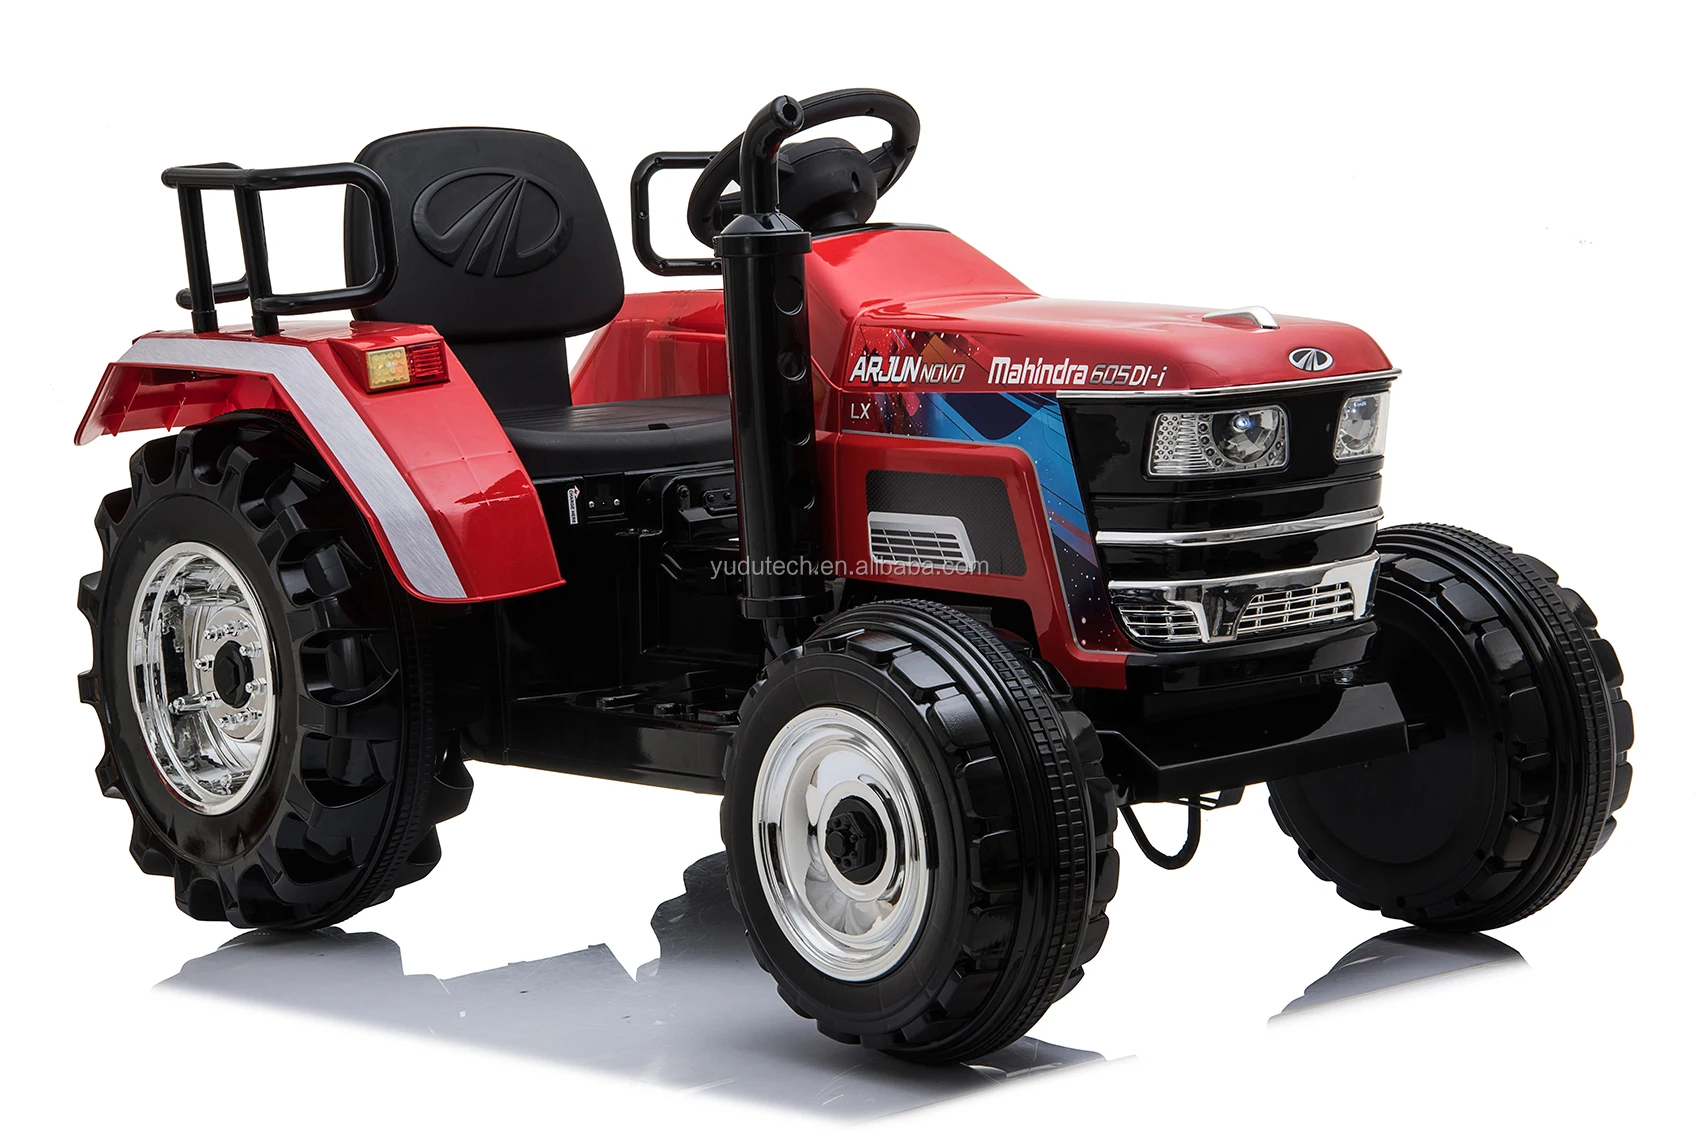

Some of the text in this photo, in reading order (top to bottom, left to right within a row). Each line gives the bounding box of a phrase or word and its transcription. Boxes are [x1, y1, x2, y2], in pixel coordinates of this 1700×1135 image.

[849, 355, 966, 384] ARJUN NOVO
[987, 356, 1089, 385] Mahindra
[850, 403, 871, 420] LX
